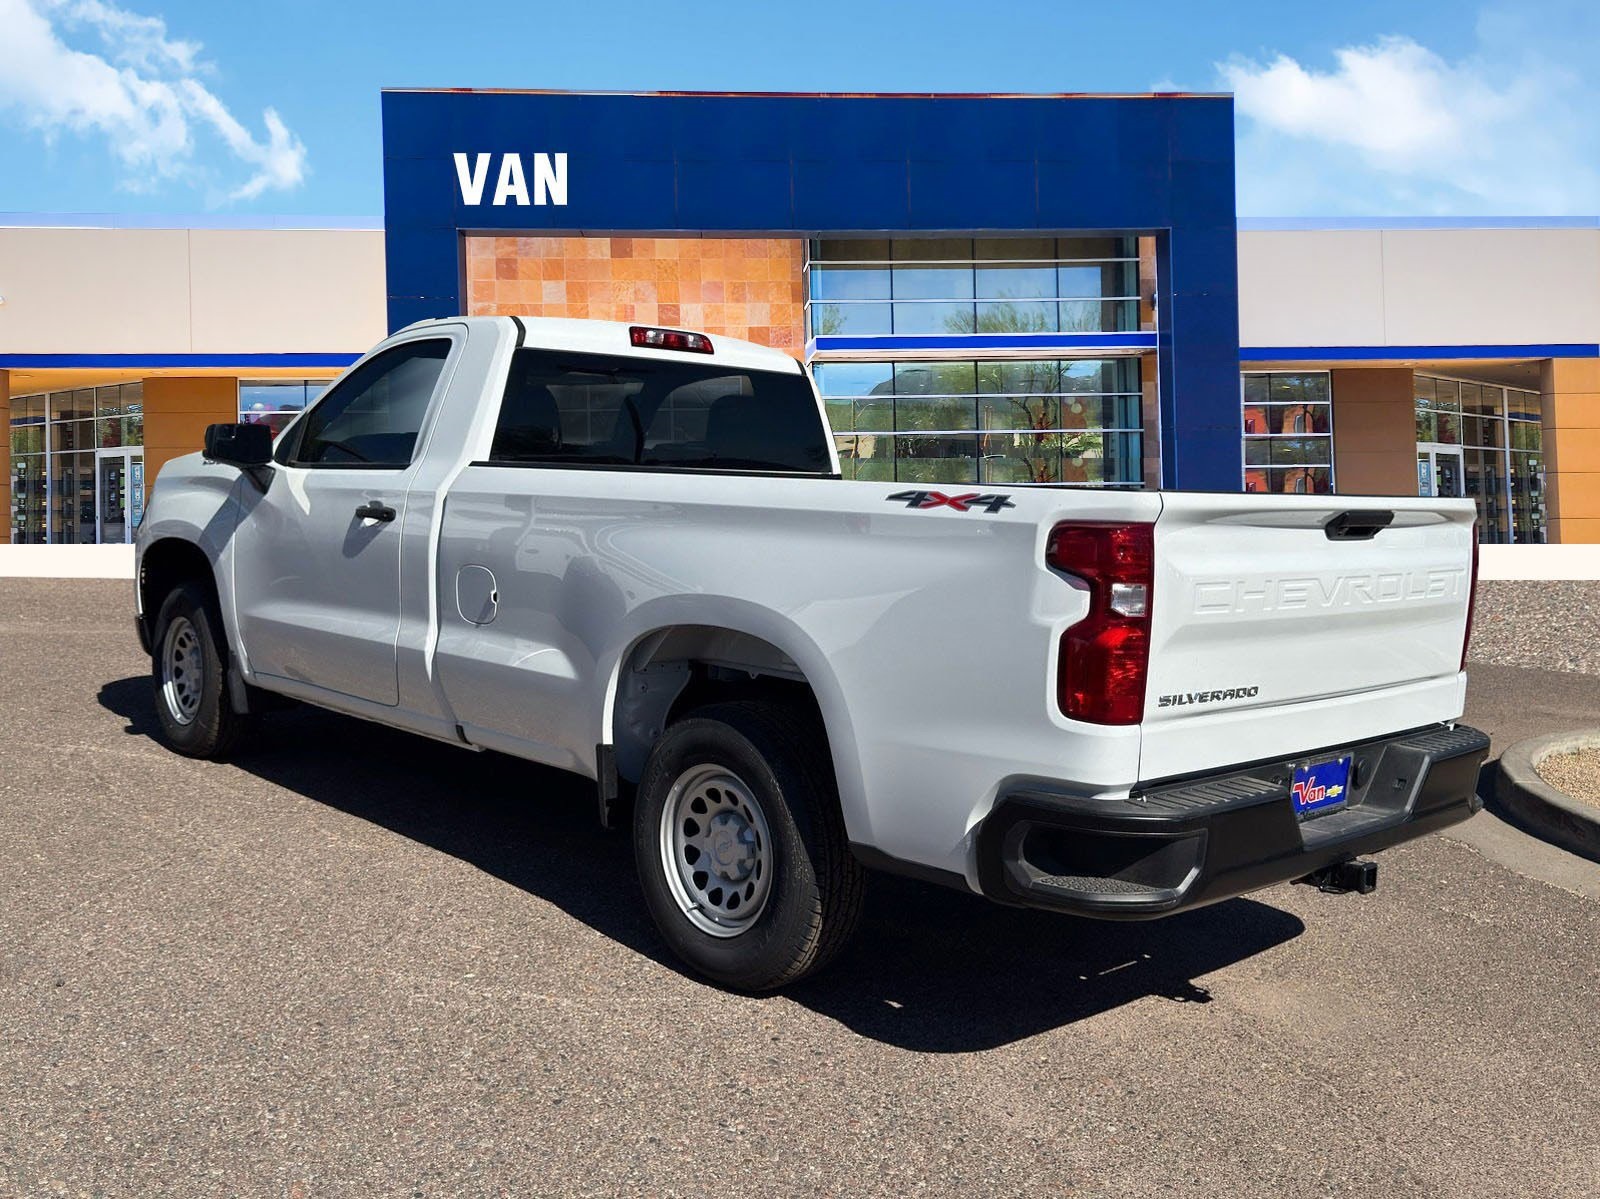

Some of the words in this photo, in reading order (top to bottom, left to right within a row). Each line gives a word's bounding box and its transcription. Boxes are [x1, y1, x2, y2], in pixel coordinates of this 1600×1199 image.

[453, 152, 568, 206] VAN
[1192, 568, 1466, 614] CHEVROLET
[1158, 686, 1259, 707] SILVERADO
[1292, 776, 1325, 805] Van
